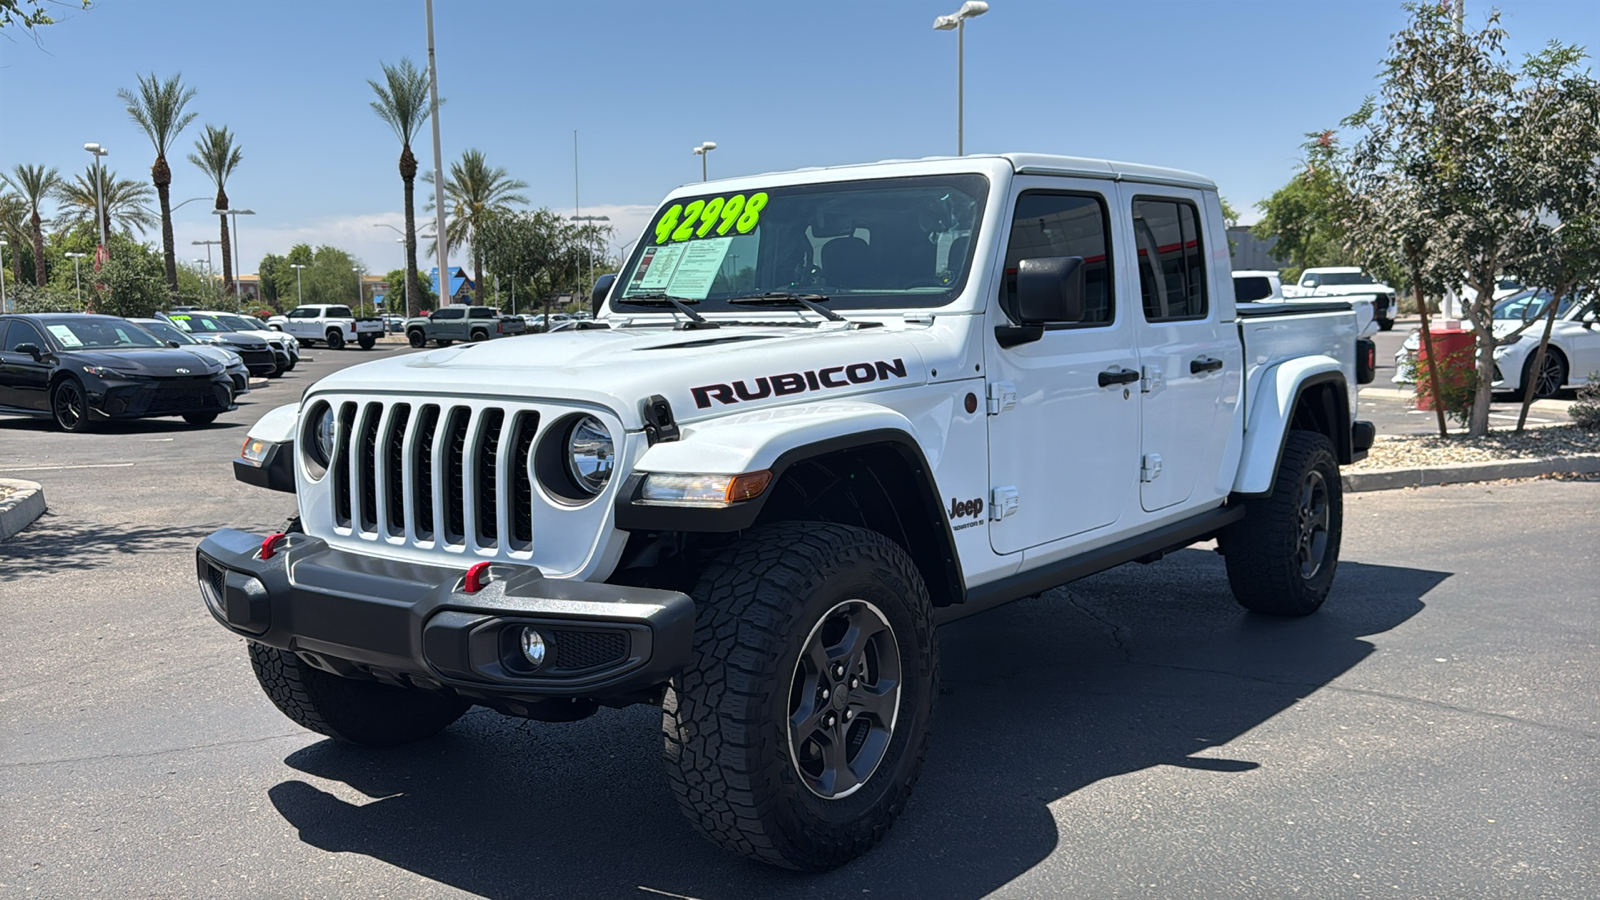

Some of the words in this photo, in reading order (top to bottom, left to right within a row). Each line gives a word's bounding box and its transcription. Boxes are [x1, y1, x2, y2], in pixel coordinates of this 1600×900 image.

[655, 192, 768, 245] 42998
[690, 358, 907, 409] RUBICON
[948, 498, 983, 519] Jeep
